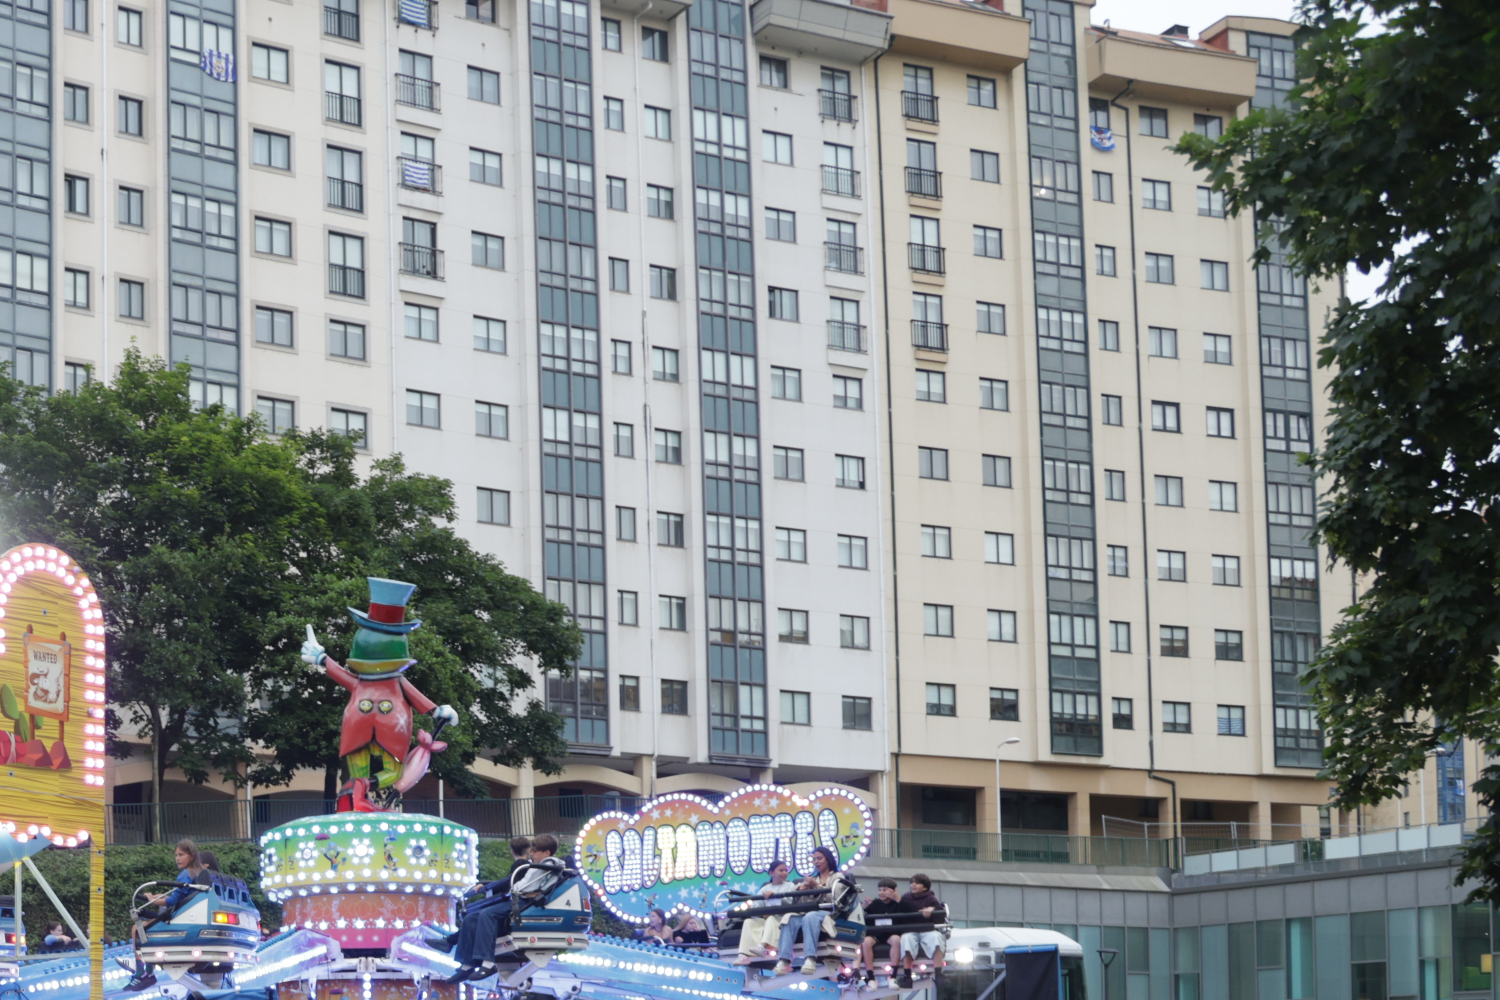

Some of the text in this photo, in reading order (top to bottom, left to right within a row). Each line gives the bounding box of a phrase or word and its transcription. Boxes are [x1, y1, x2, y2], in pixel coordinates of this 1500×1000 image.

[32, 650, 58, 664] WANTED
[602, 808, 840, 894] SALTAMONTES
[565, 899, 571, 907] 4
[189, 912, 196, 920] 3
